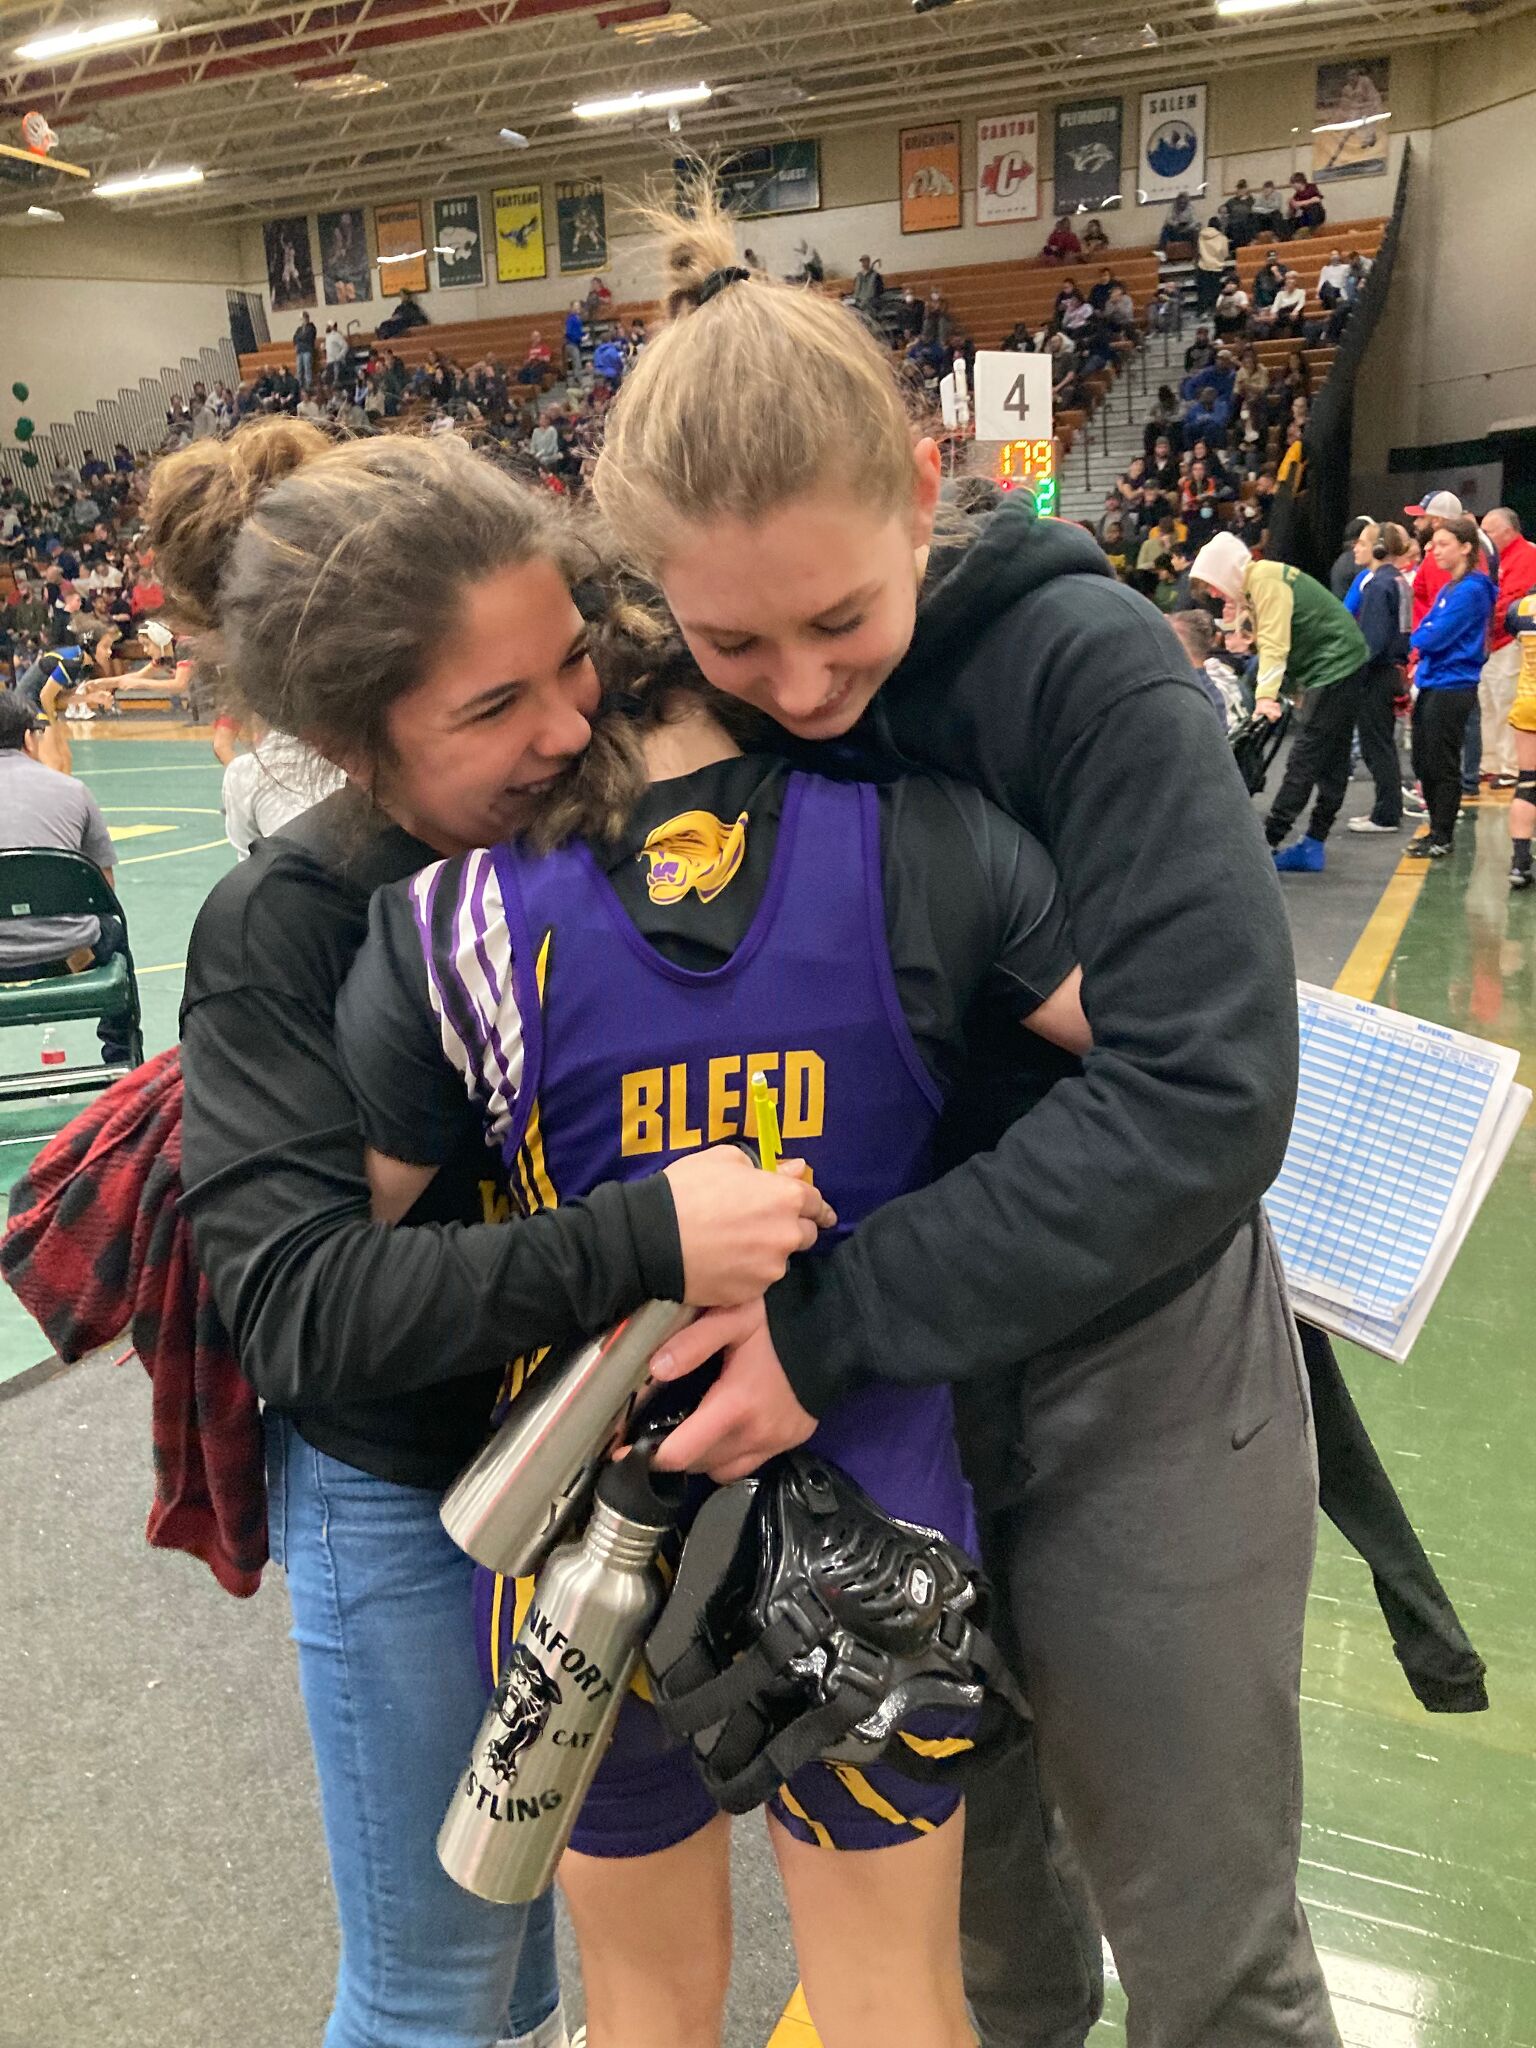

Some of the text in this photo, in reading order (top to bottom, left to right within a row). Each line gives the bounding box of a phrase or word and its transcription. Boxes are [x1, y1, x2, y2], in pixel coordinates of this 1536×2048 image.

[1149, 93, 1197, 114] SALEM
[1003, 373, 1030, 421] 4
[1002, 440, 1052, 478] 179
[621, 1050, 825, 1157] BLEED
